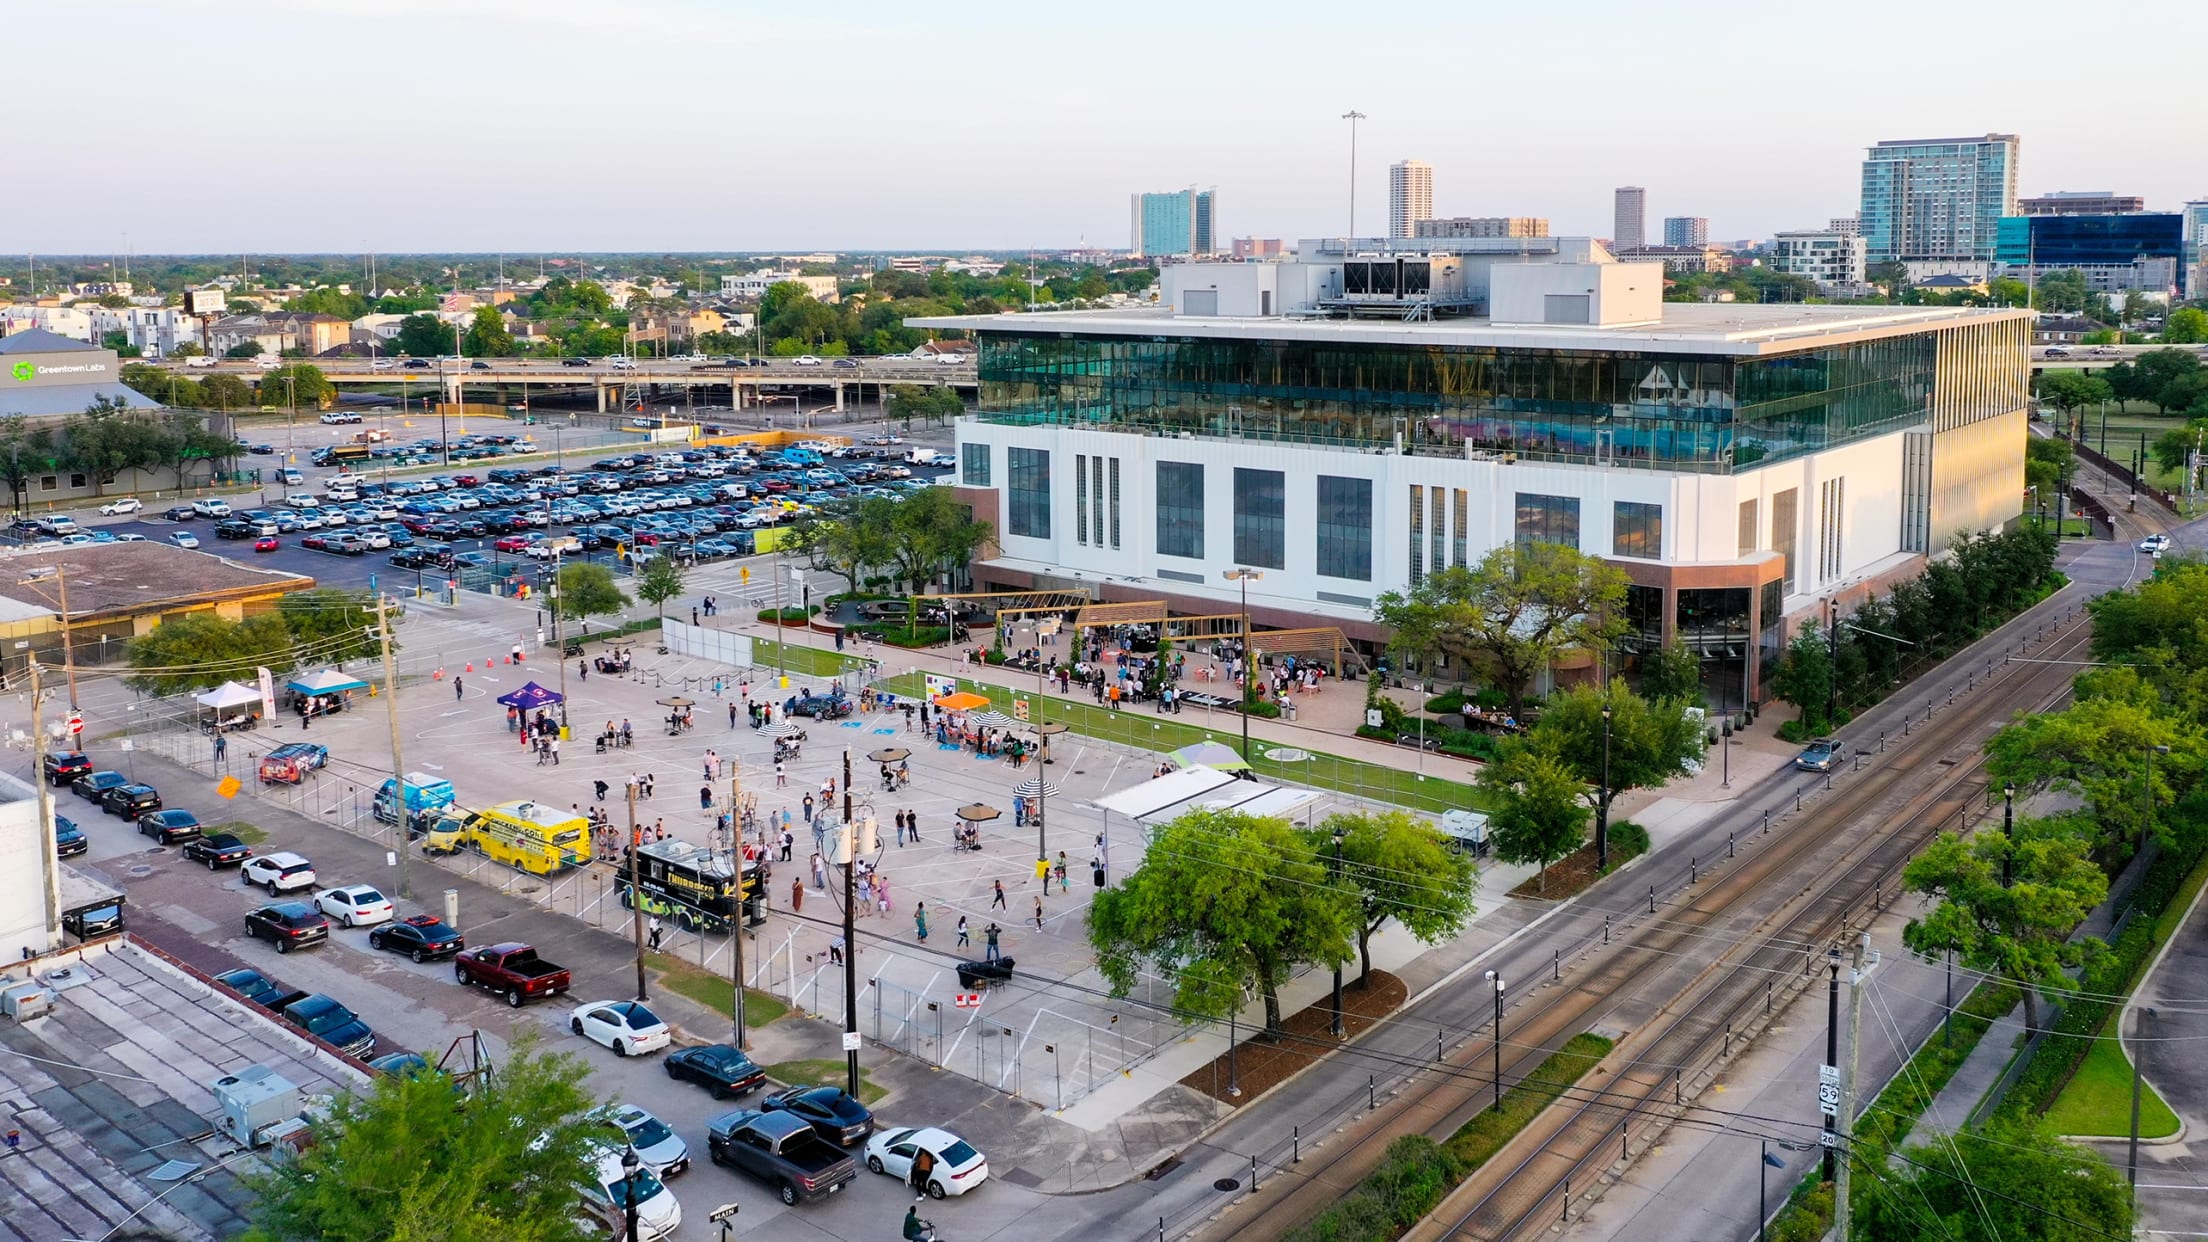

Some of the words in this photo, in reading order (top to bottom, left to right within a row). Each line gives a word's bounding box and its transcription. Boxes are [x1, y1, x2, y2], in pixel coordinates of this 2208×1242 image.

[38, 365, 85, 374] Greentown
[85, 363, 106, 372] Labs
[1821, 1087, 1837, 1100] 59
[1822, 1135, 1834, 1144] 20
[714, 1208, 735, 1220] MAIN
